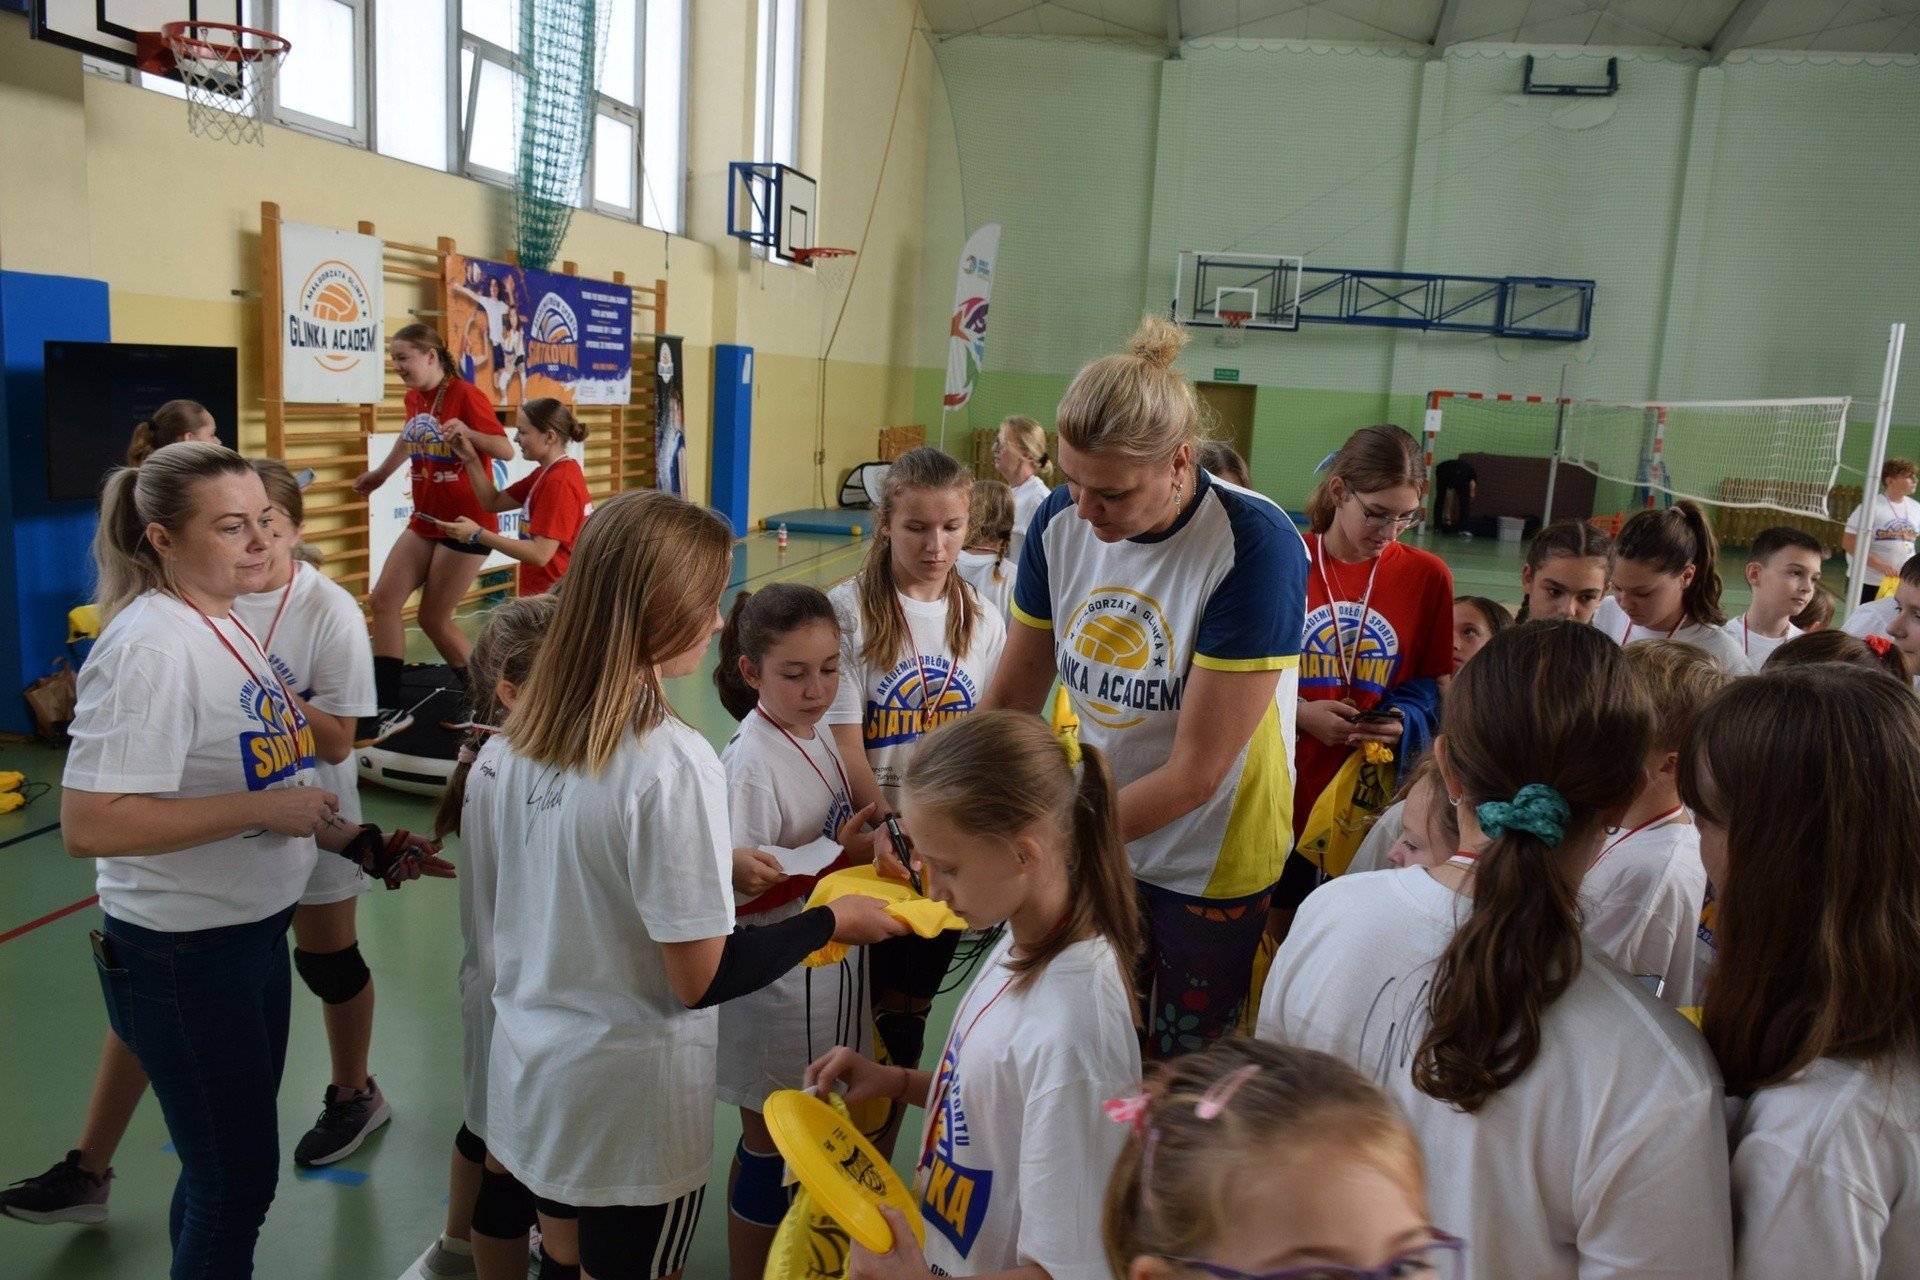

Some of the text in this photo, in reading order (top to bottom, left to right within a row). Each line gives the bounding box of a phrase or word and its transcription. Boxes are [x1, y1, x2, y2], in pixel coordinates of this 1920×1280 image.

[289, 314, 328, 349] GLINKA
[1076, 598, 1164, 650] GORZATA GLINKA
[1369, 615, 1396, 647] SPORTU
